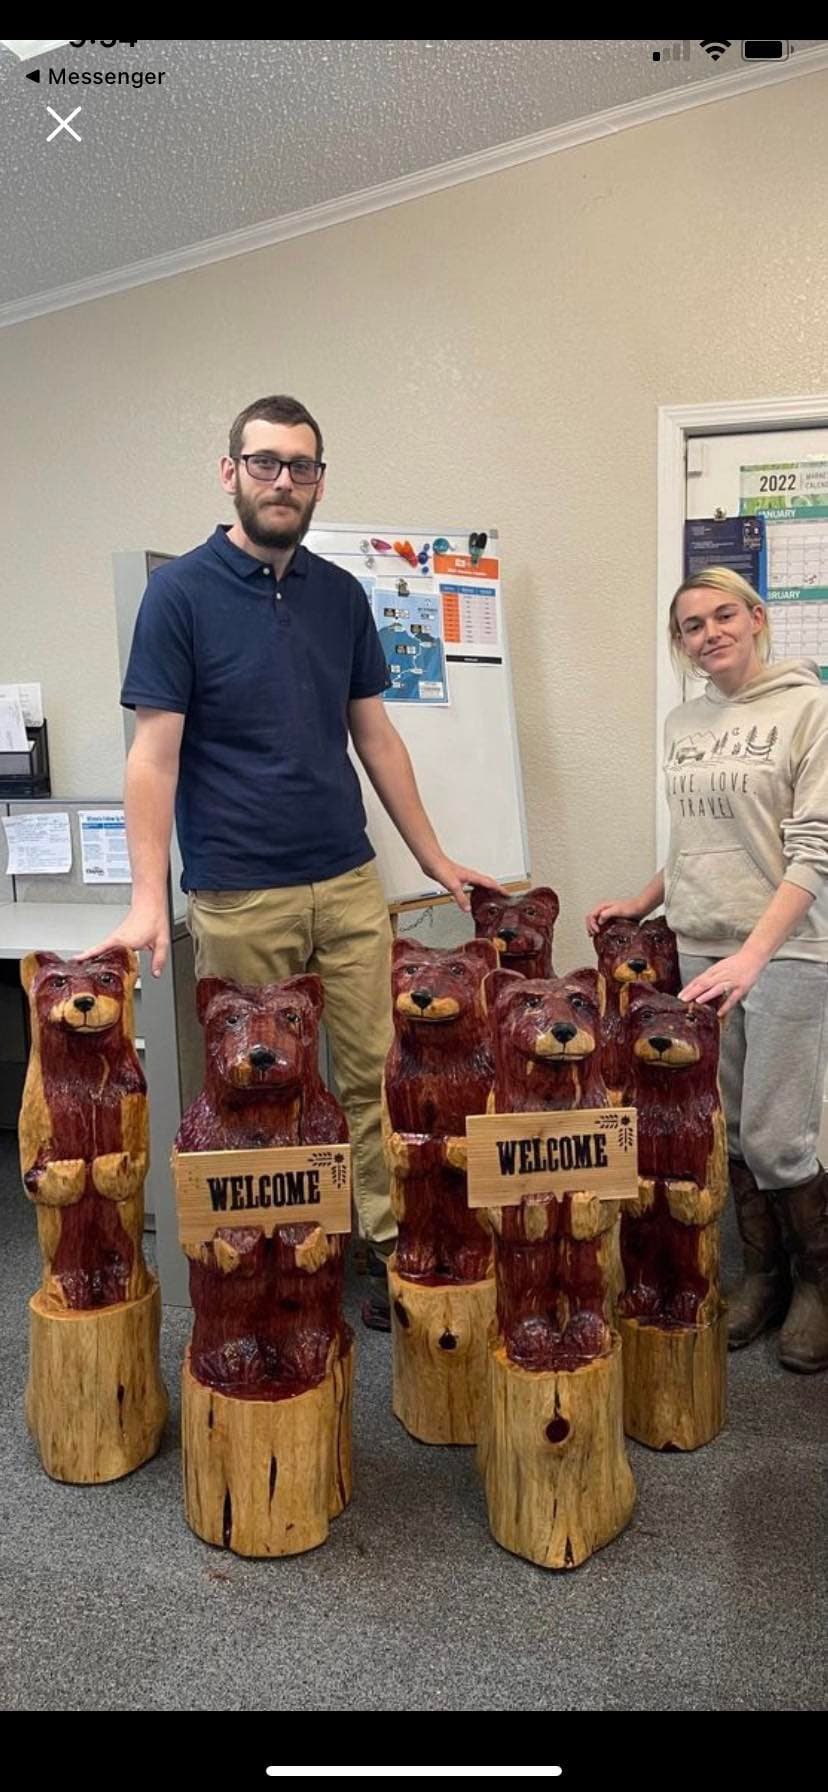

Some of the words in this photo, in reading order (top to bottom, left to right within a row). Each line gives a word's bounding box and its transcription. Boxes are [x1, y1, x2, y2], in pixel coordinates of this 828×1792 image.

[759, 474, 797, 492] 2022
[495, 1132, 609, 1176] WELCOME
[206, 1169, 321, 1212] WELCOME
